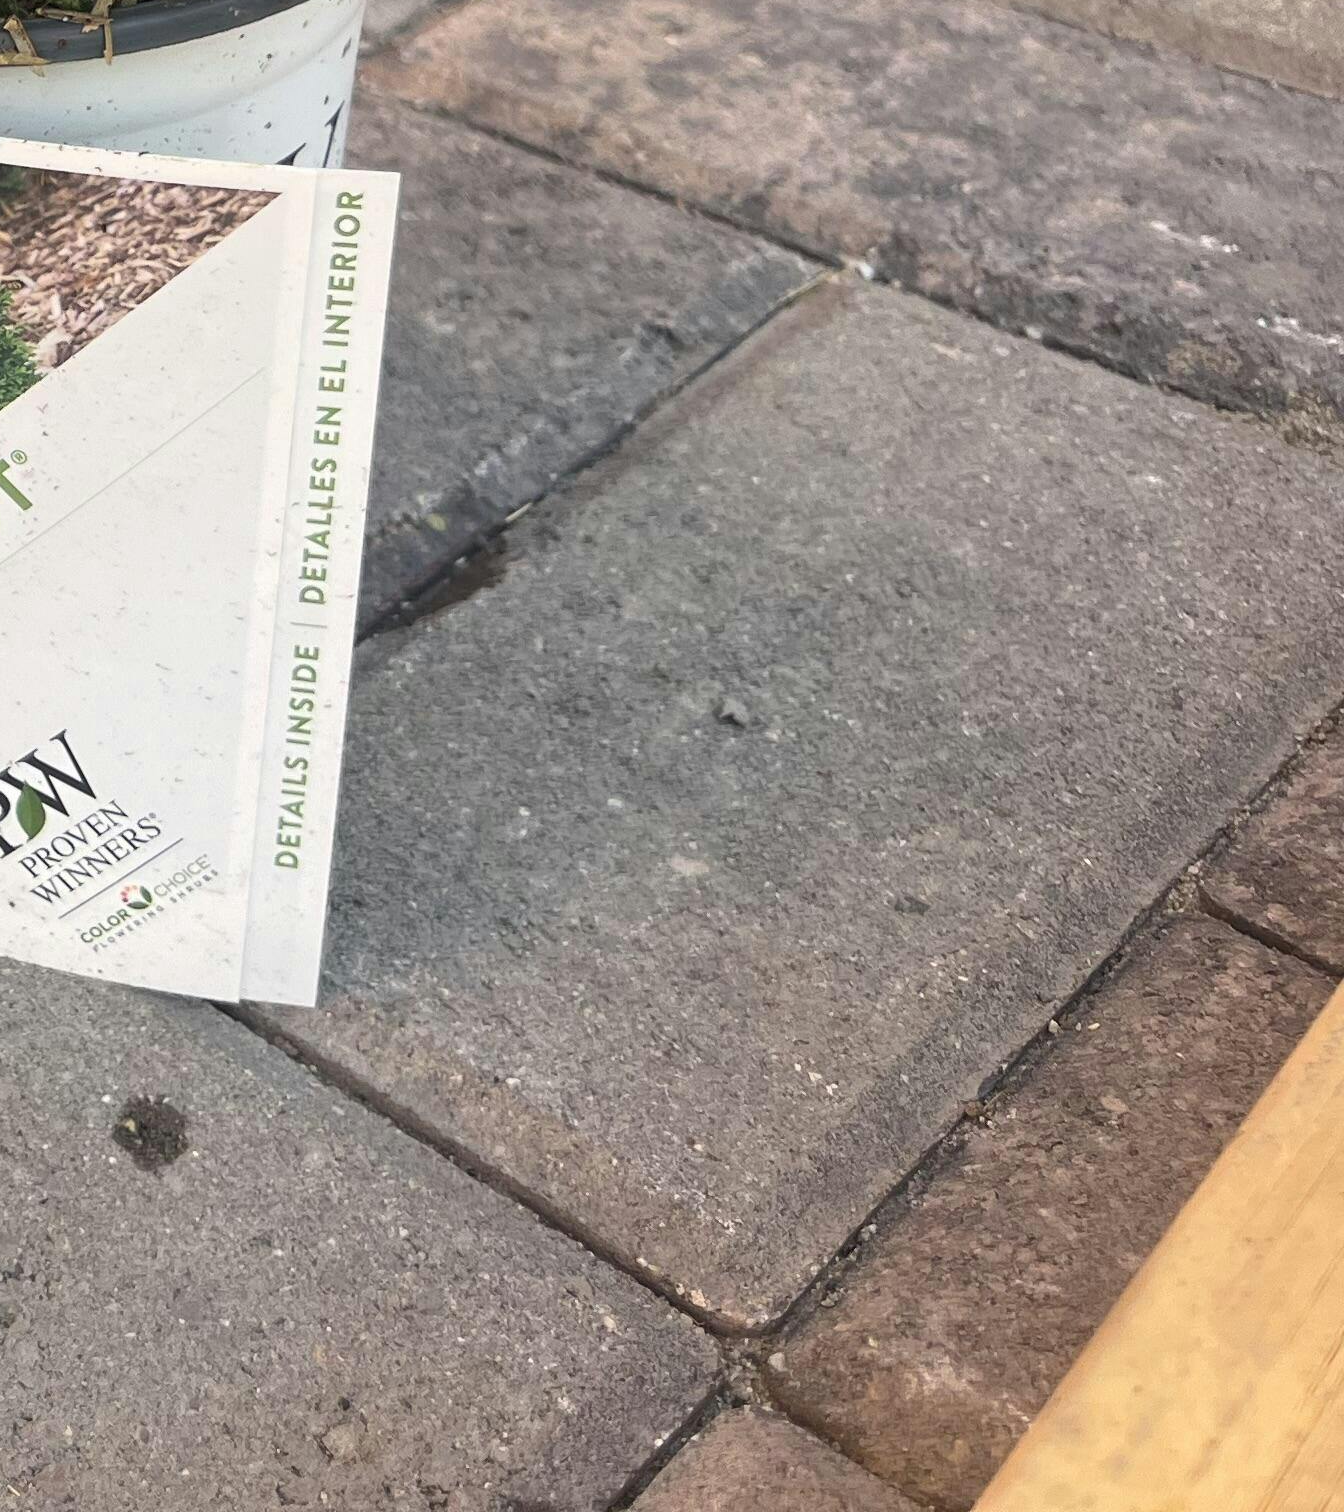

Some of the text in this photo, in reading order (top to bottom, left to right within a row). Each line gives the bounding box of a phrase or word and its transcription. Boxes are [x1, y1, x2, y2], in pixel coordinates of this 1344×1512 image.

[274, 190, 365, 869] DETAILS INSIDE DETALLES EN EL INTERIOR
[18, 799, 130, 878] PROVEN
[80, 908, 132, 944] COLOR
